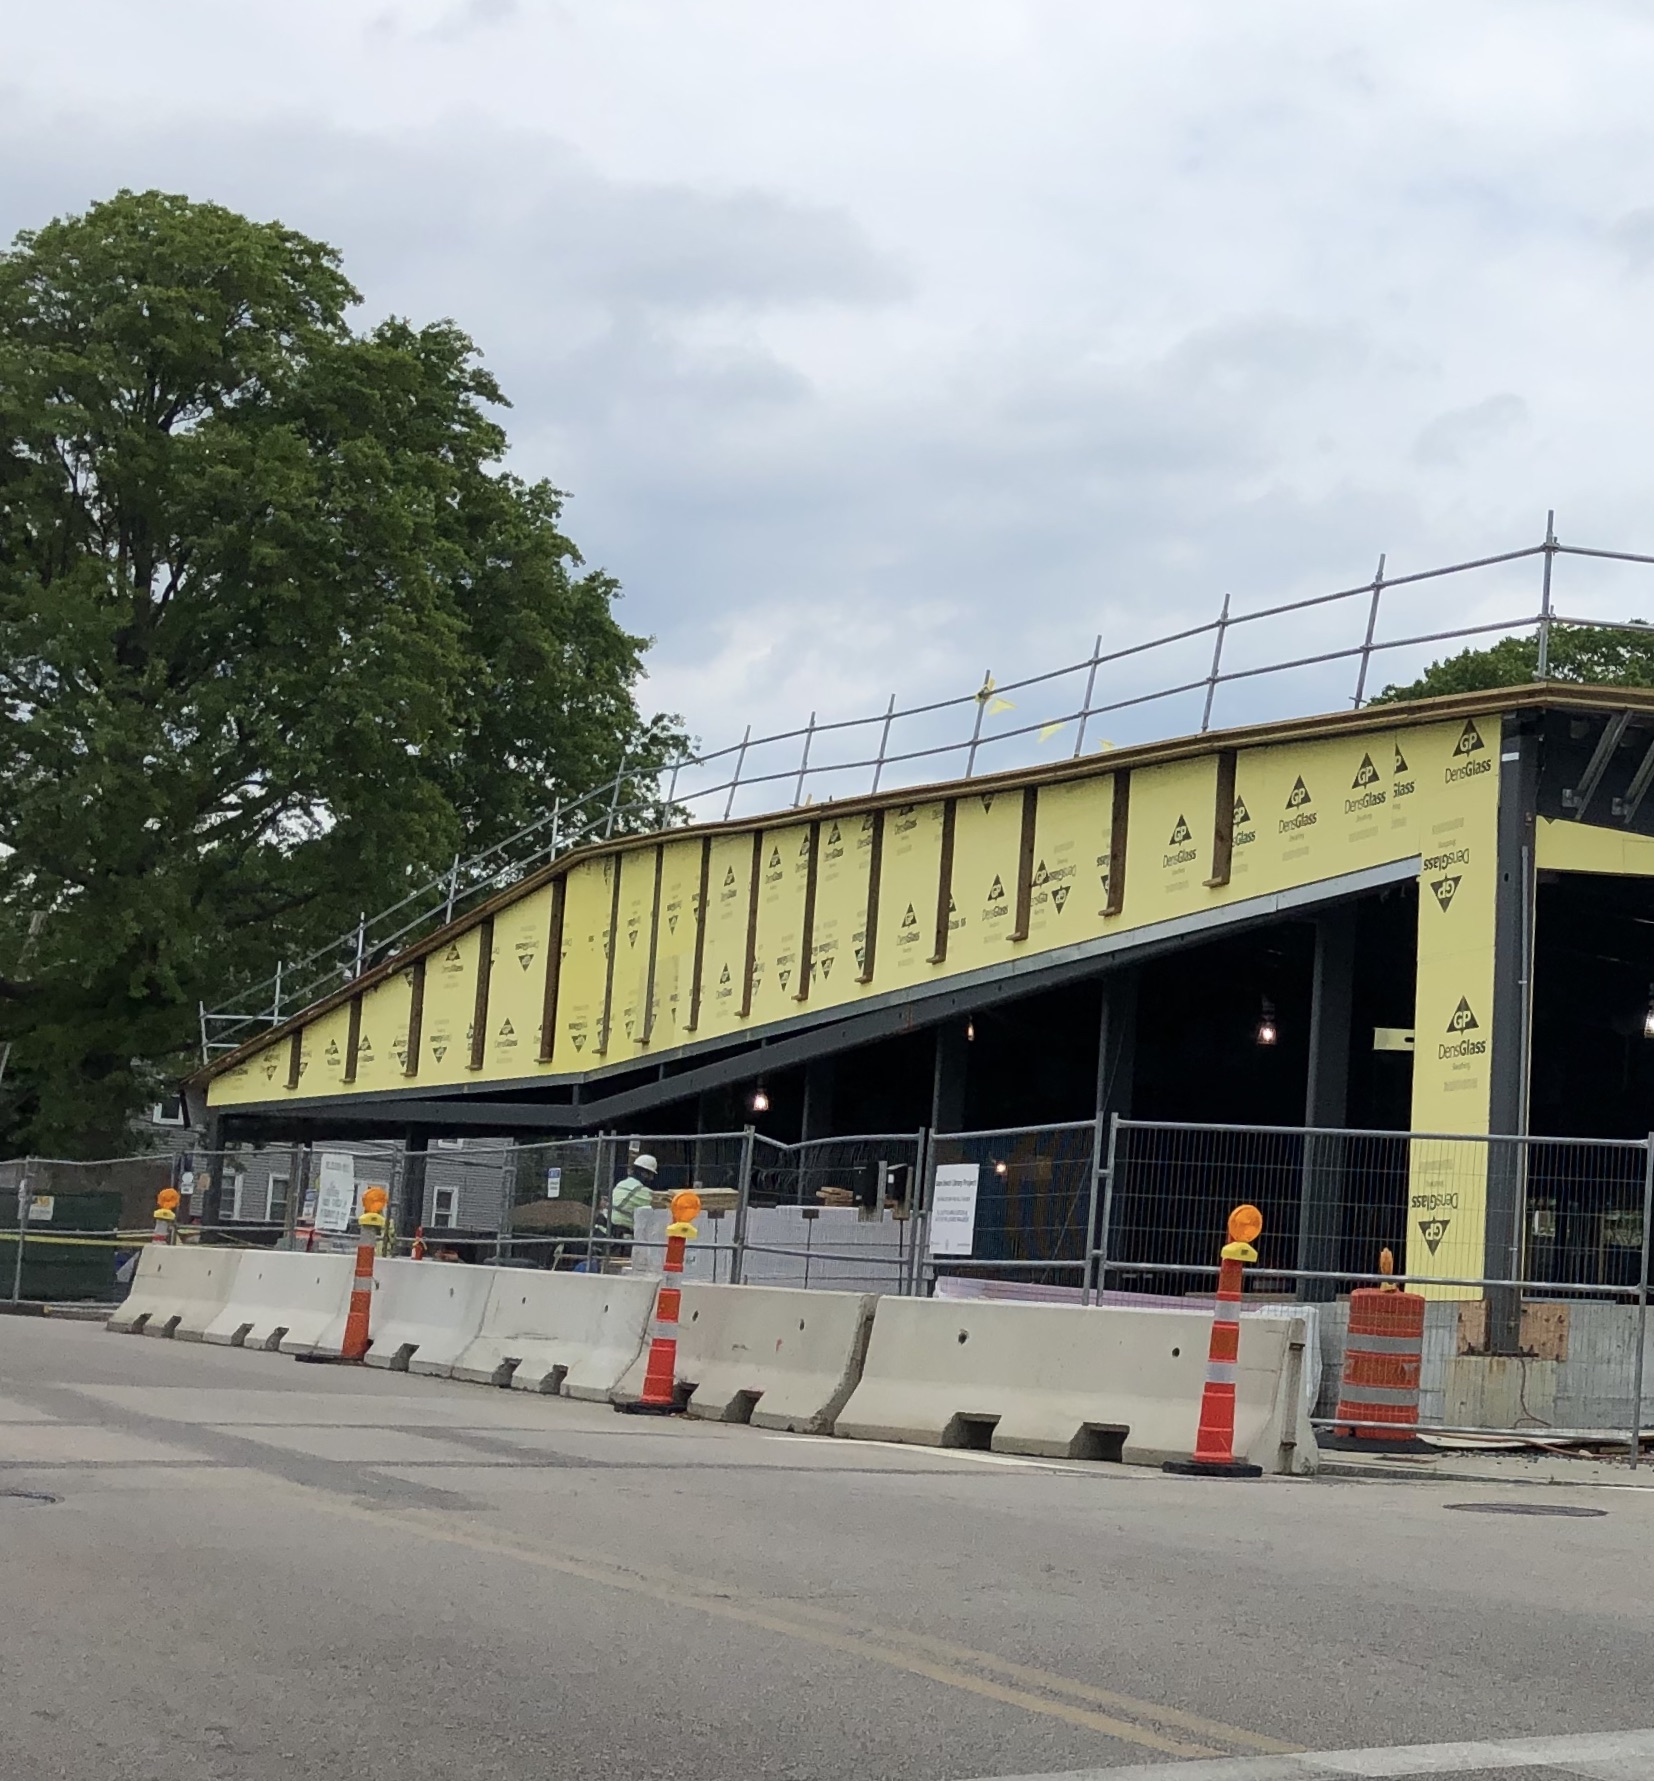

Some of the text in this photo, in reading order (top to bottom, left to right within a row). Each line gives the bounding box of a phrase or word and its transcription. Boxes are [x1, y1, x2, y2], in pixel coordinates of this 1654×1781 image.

[1460, 732, 1477, 752] GP
[1358, 765, 1373, 784] GP
[1445, 759, 1491, 784] DensGlass
[1291, 788, 1306, 806] GP
[1345, 791, 1386, 814] DensGlass
[1279, 812, 1317, 834] DensGlass
[1174, 825, 1187, 842] GP
[1163, 849, 1197, 868] DensGlass
[1424, 848, 1470, 871] DensGlass
[1437, 880, 1455, 899] GP
[1453, 1010, 1472, 1029] GP
[1438, 1039, 1486, 1060] DensGlass
[1411, 1192, 1458, 1211] DensGlass
[1425, 1222, 1443, 1241] GP
